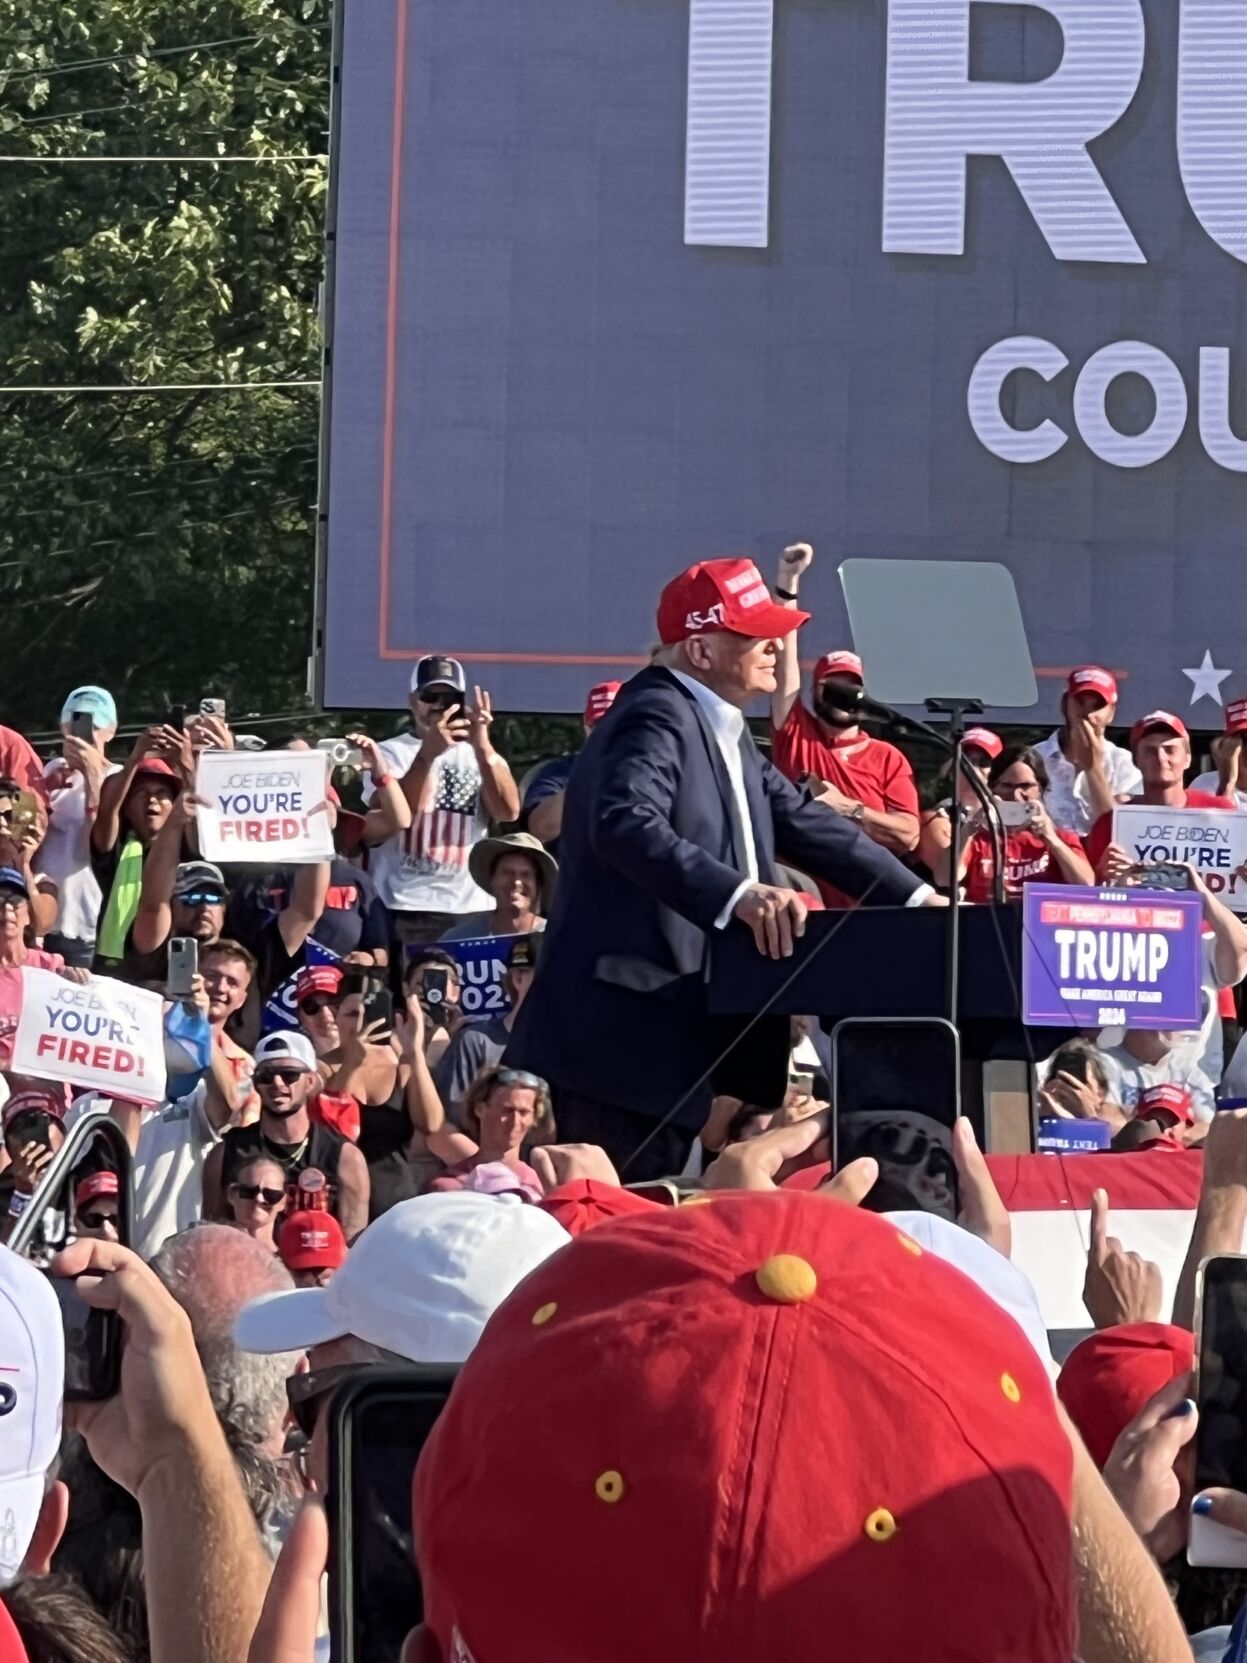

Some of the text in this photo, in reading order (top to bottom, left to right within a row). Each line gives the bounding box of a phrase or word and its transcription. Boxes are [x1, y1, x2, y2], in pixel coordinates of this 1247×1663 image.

[221, 773, 252, 788] JOE
[219, 792, 302, 814] YOU'RE
[219, 817, 310, 842] FIRED!
[1138, 825, 1229, 843] JOE BIDEN
[1134, 844, 1231, 867] YOU'RE
[1054, 929, 1169, 982] TRUMP
[51, 988, 87, 1007] JOE
[462, 984, 511, 1010] 02
[37, 1033, 145, 1077] FIRED!
